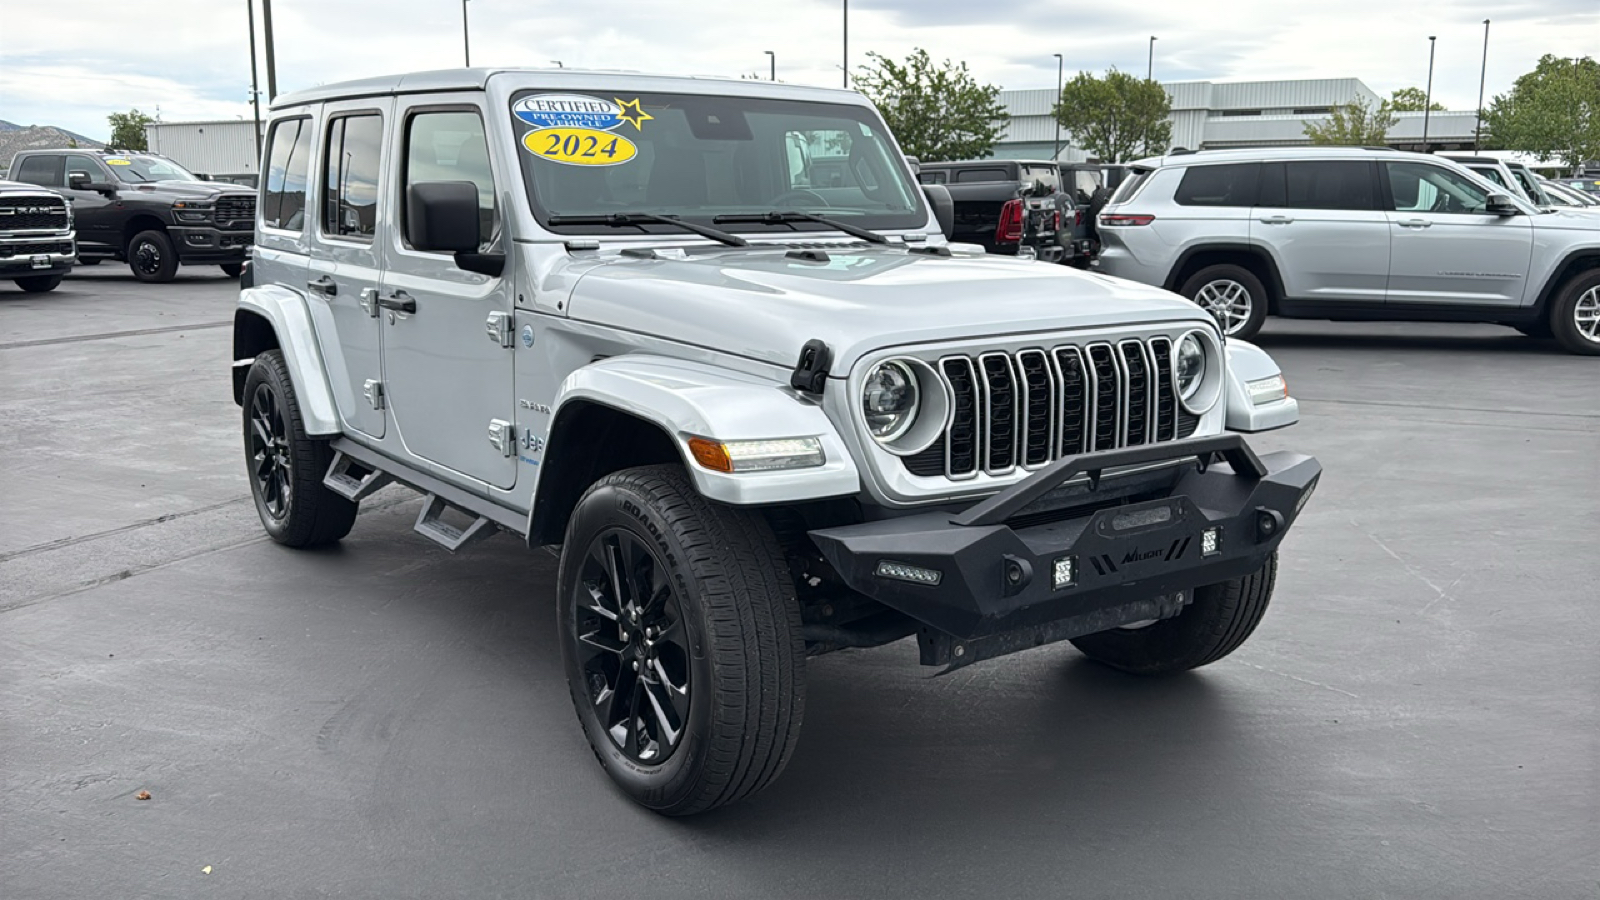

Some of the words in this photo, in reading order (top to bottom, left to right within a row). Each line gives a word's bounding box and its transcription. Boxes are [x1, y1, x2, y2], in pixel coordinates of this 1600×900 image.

[524, 100, 611, 113] CERTIFIED
[533, 113, 611, 121] PRE-OWNED
[547, 120, 603, 128] VEHICLE
[544, 134, 619, 158] 2024
[623, 500, 678, 568] ROADIAN
